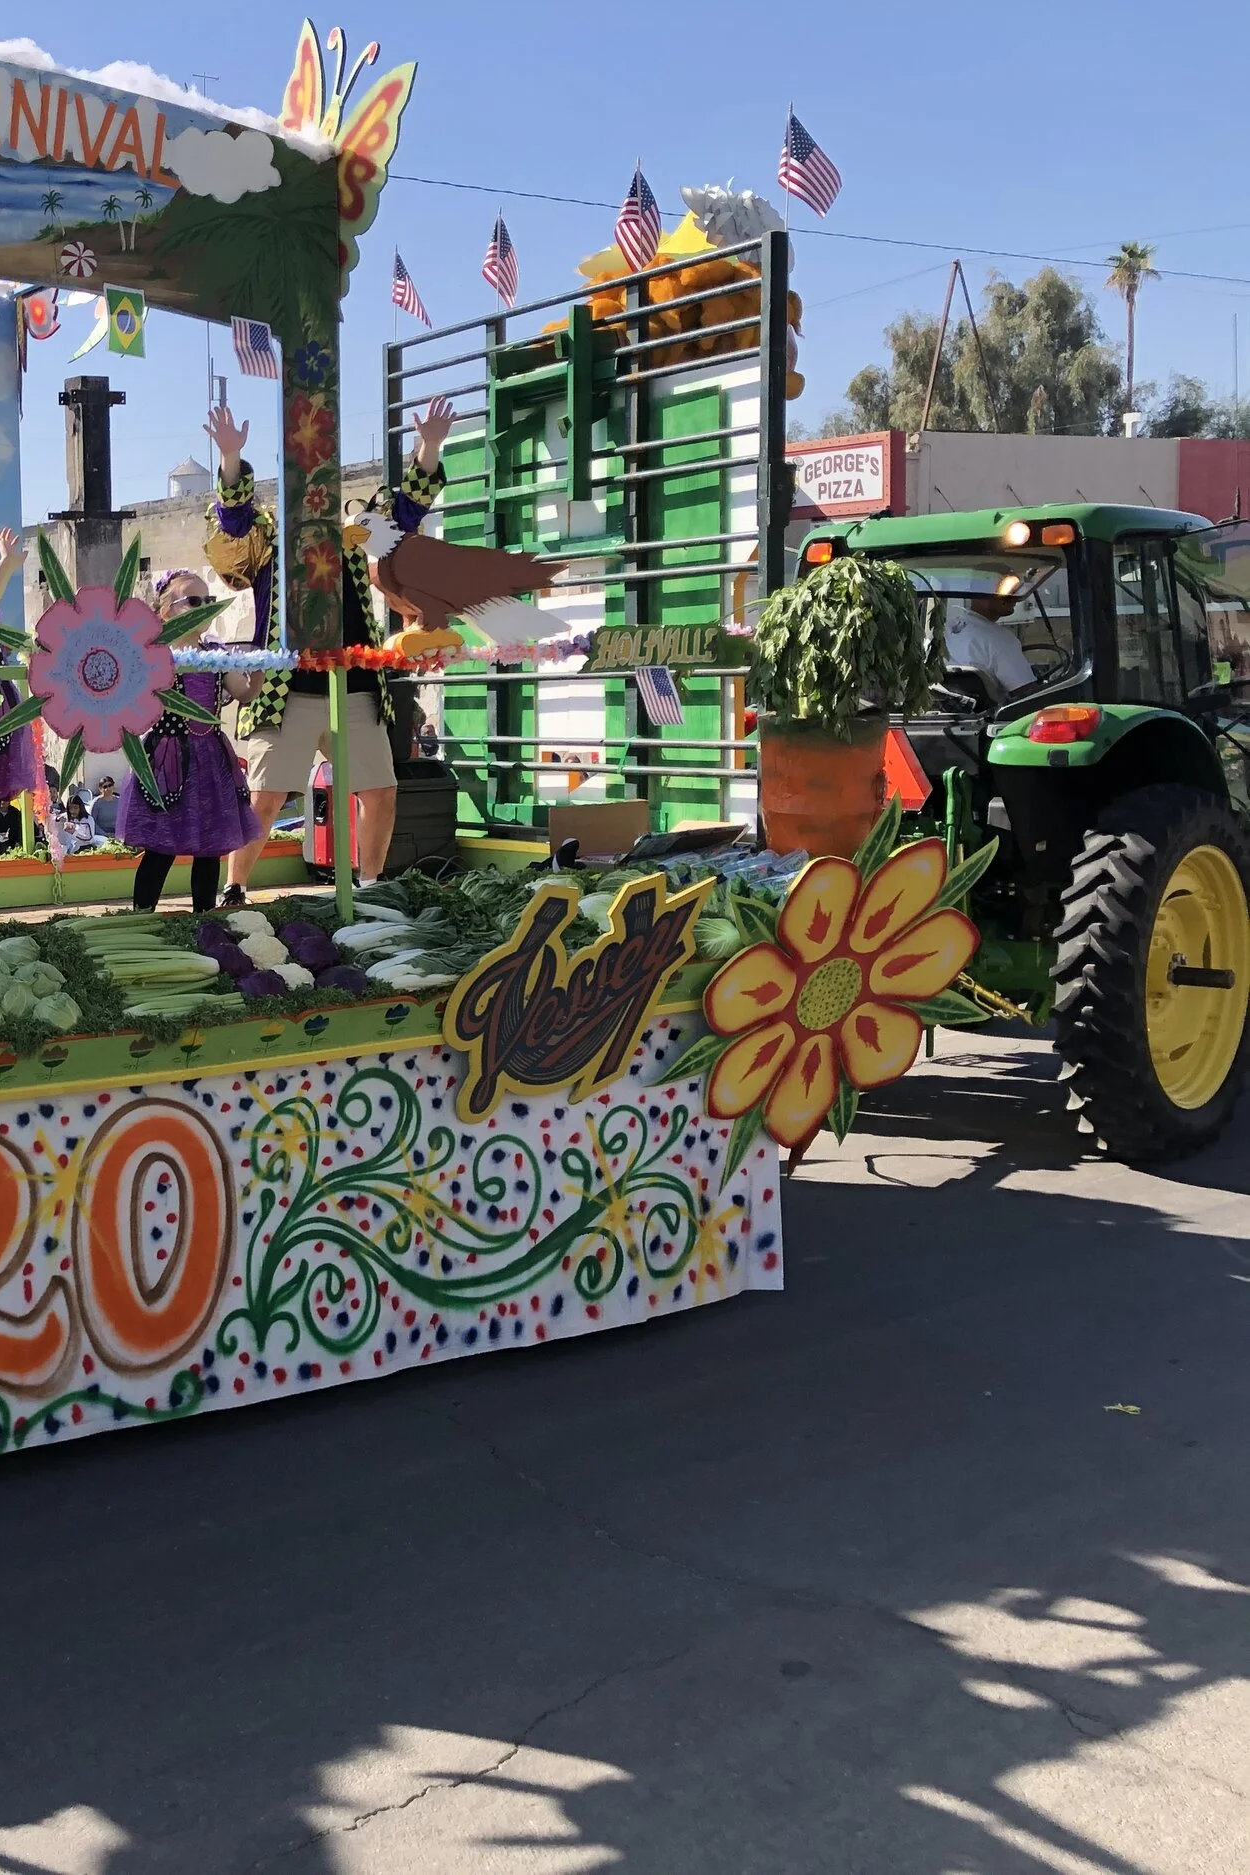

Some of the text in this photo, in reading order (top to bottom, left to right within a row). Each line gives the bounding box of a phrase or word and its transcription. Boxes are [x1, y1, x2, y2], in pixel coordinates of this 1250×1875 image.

[804, 453, 880, 484] GEORGE'S
[818, 479, 864, 500] PIZZA
[455, 890, 700, 1114] Vessey
